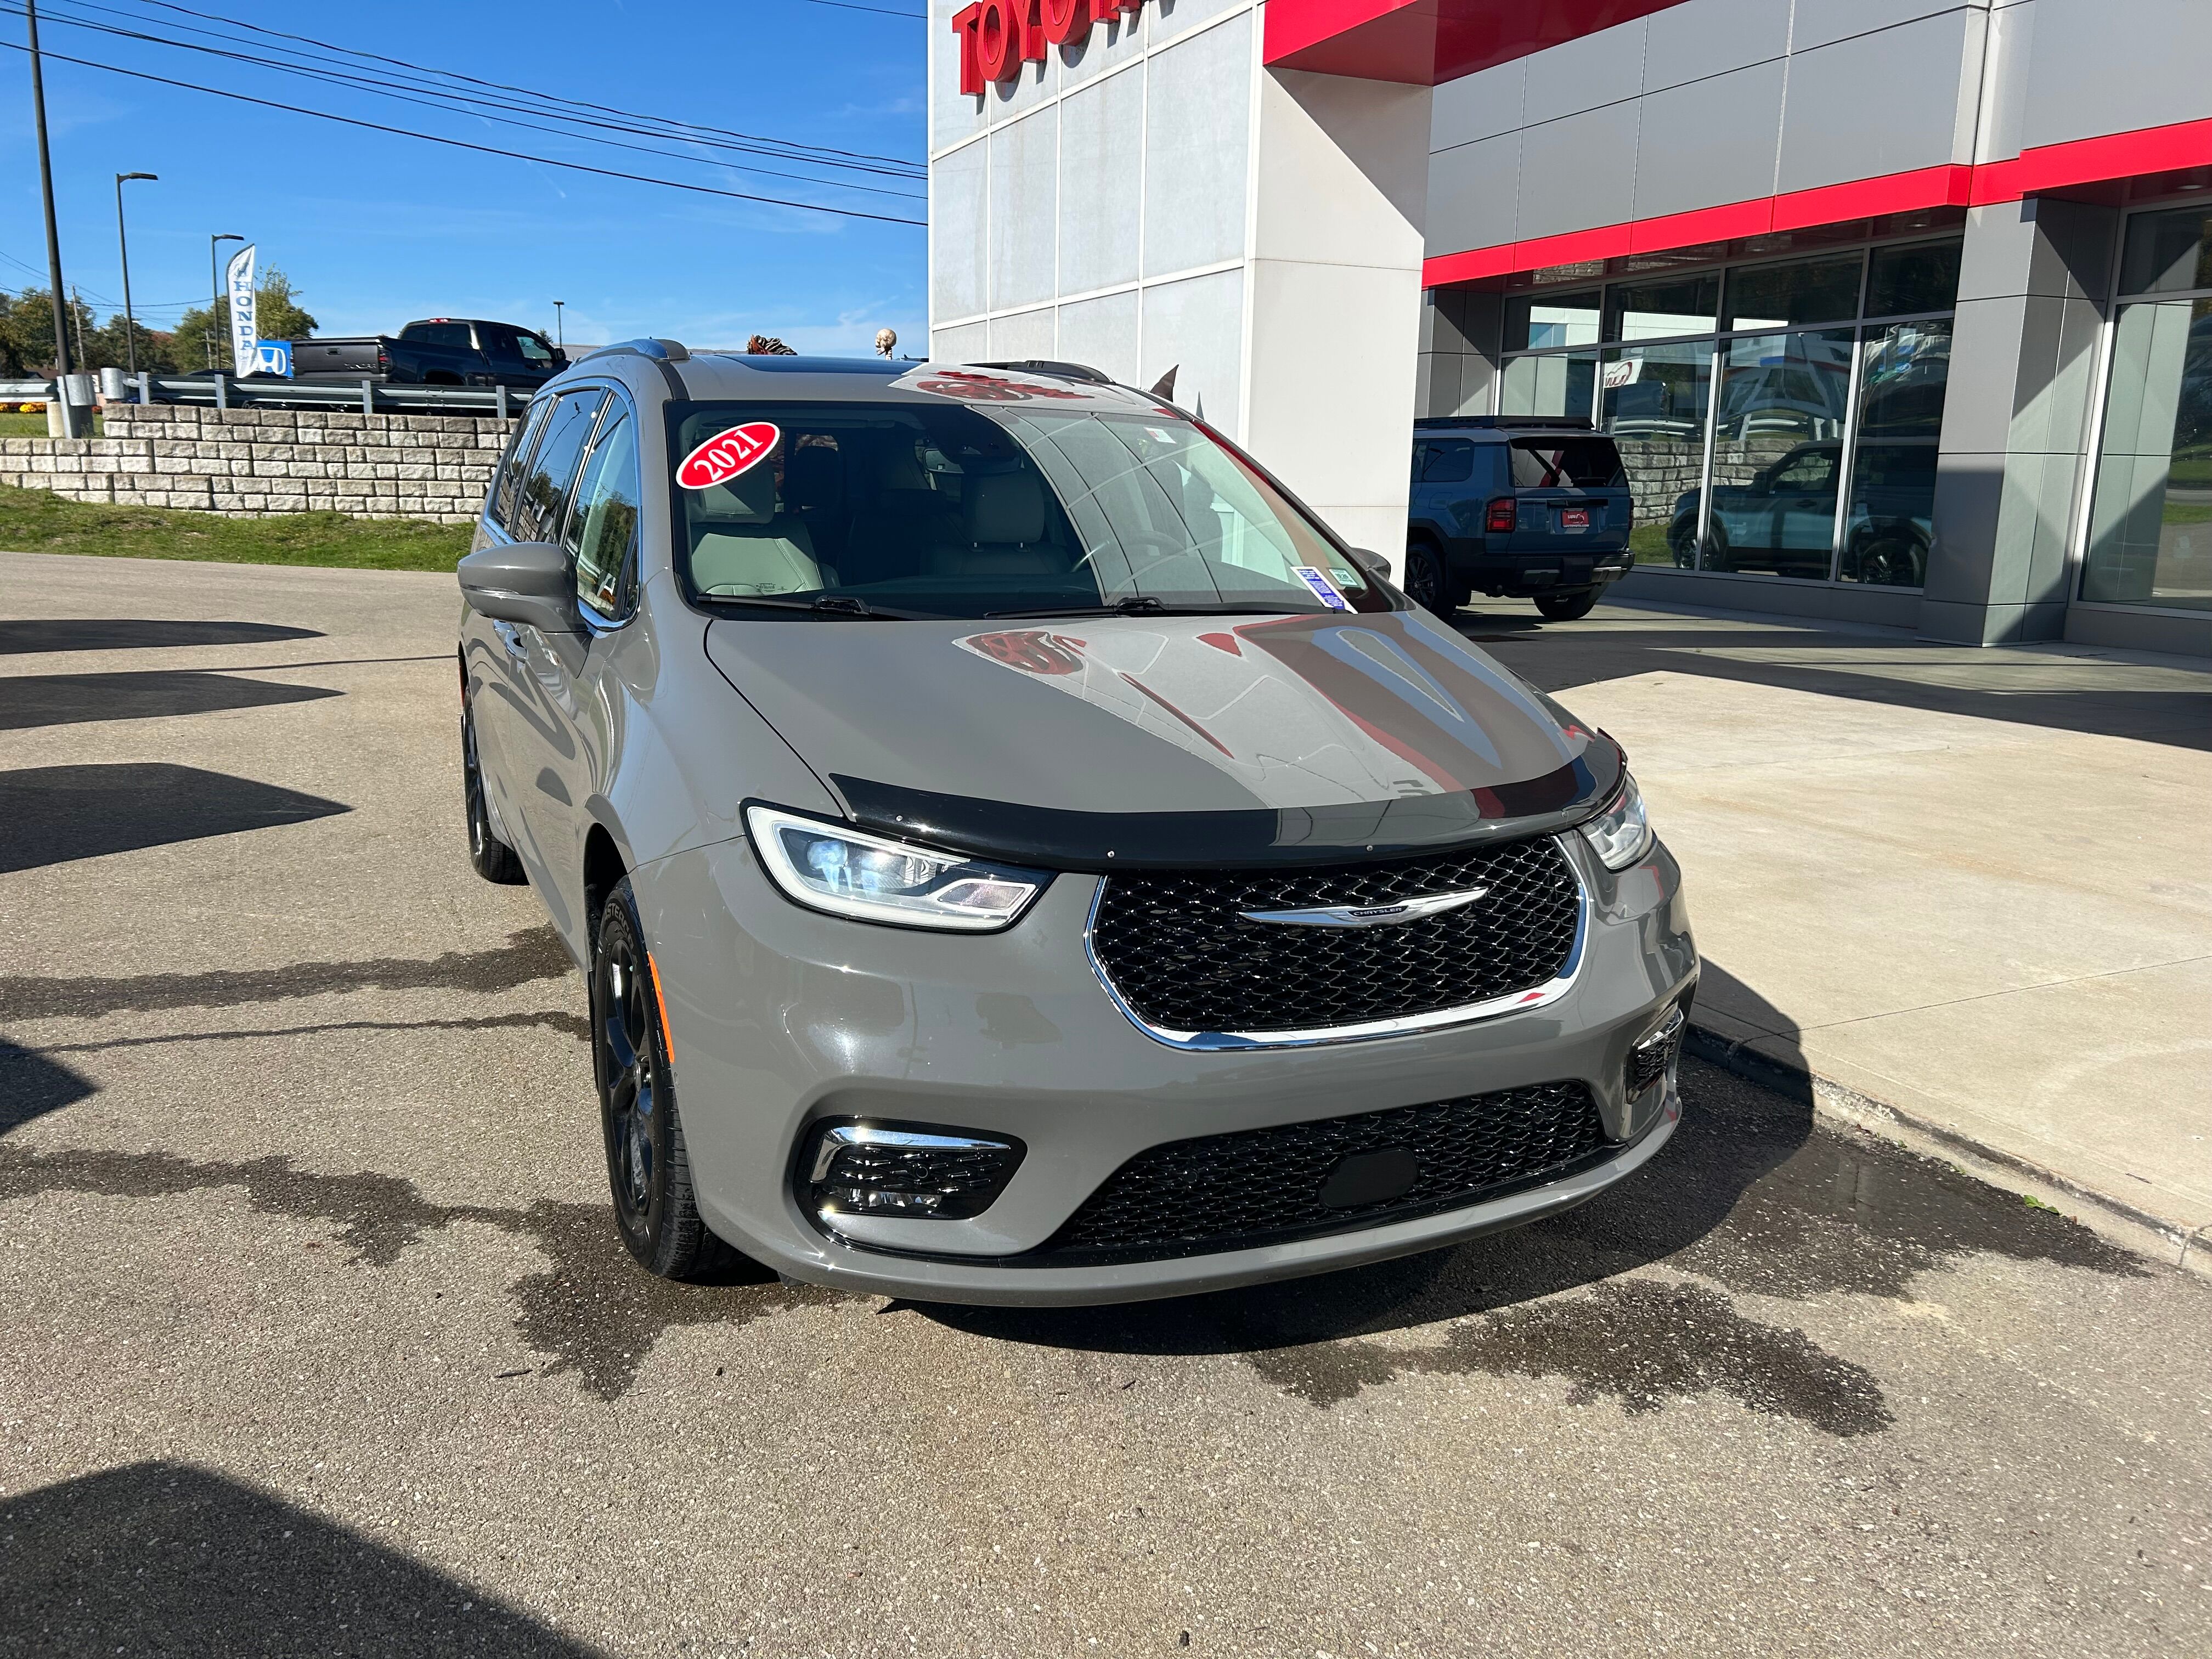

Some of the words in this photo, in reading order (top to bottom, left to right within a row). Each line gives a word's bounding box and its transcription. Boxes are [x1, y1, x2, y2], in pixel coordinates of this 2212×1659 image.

[952, 0, 1140, 96] TOYO
[233, 280, 253, 351] HONDA
[693, 429, 763, 481] 2021
[1353, 907, 1402, 916] CHRYSLER
